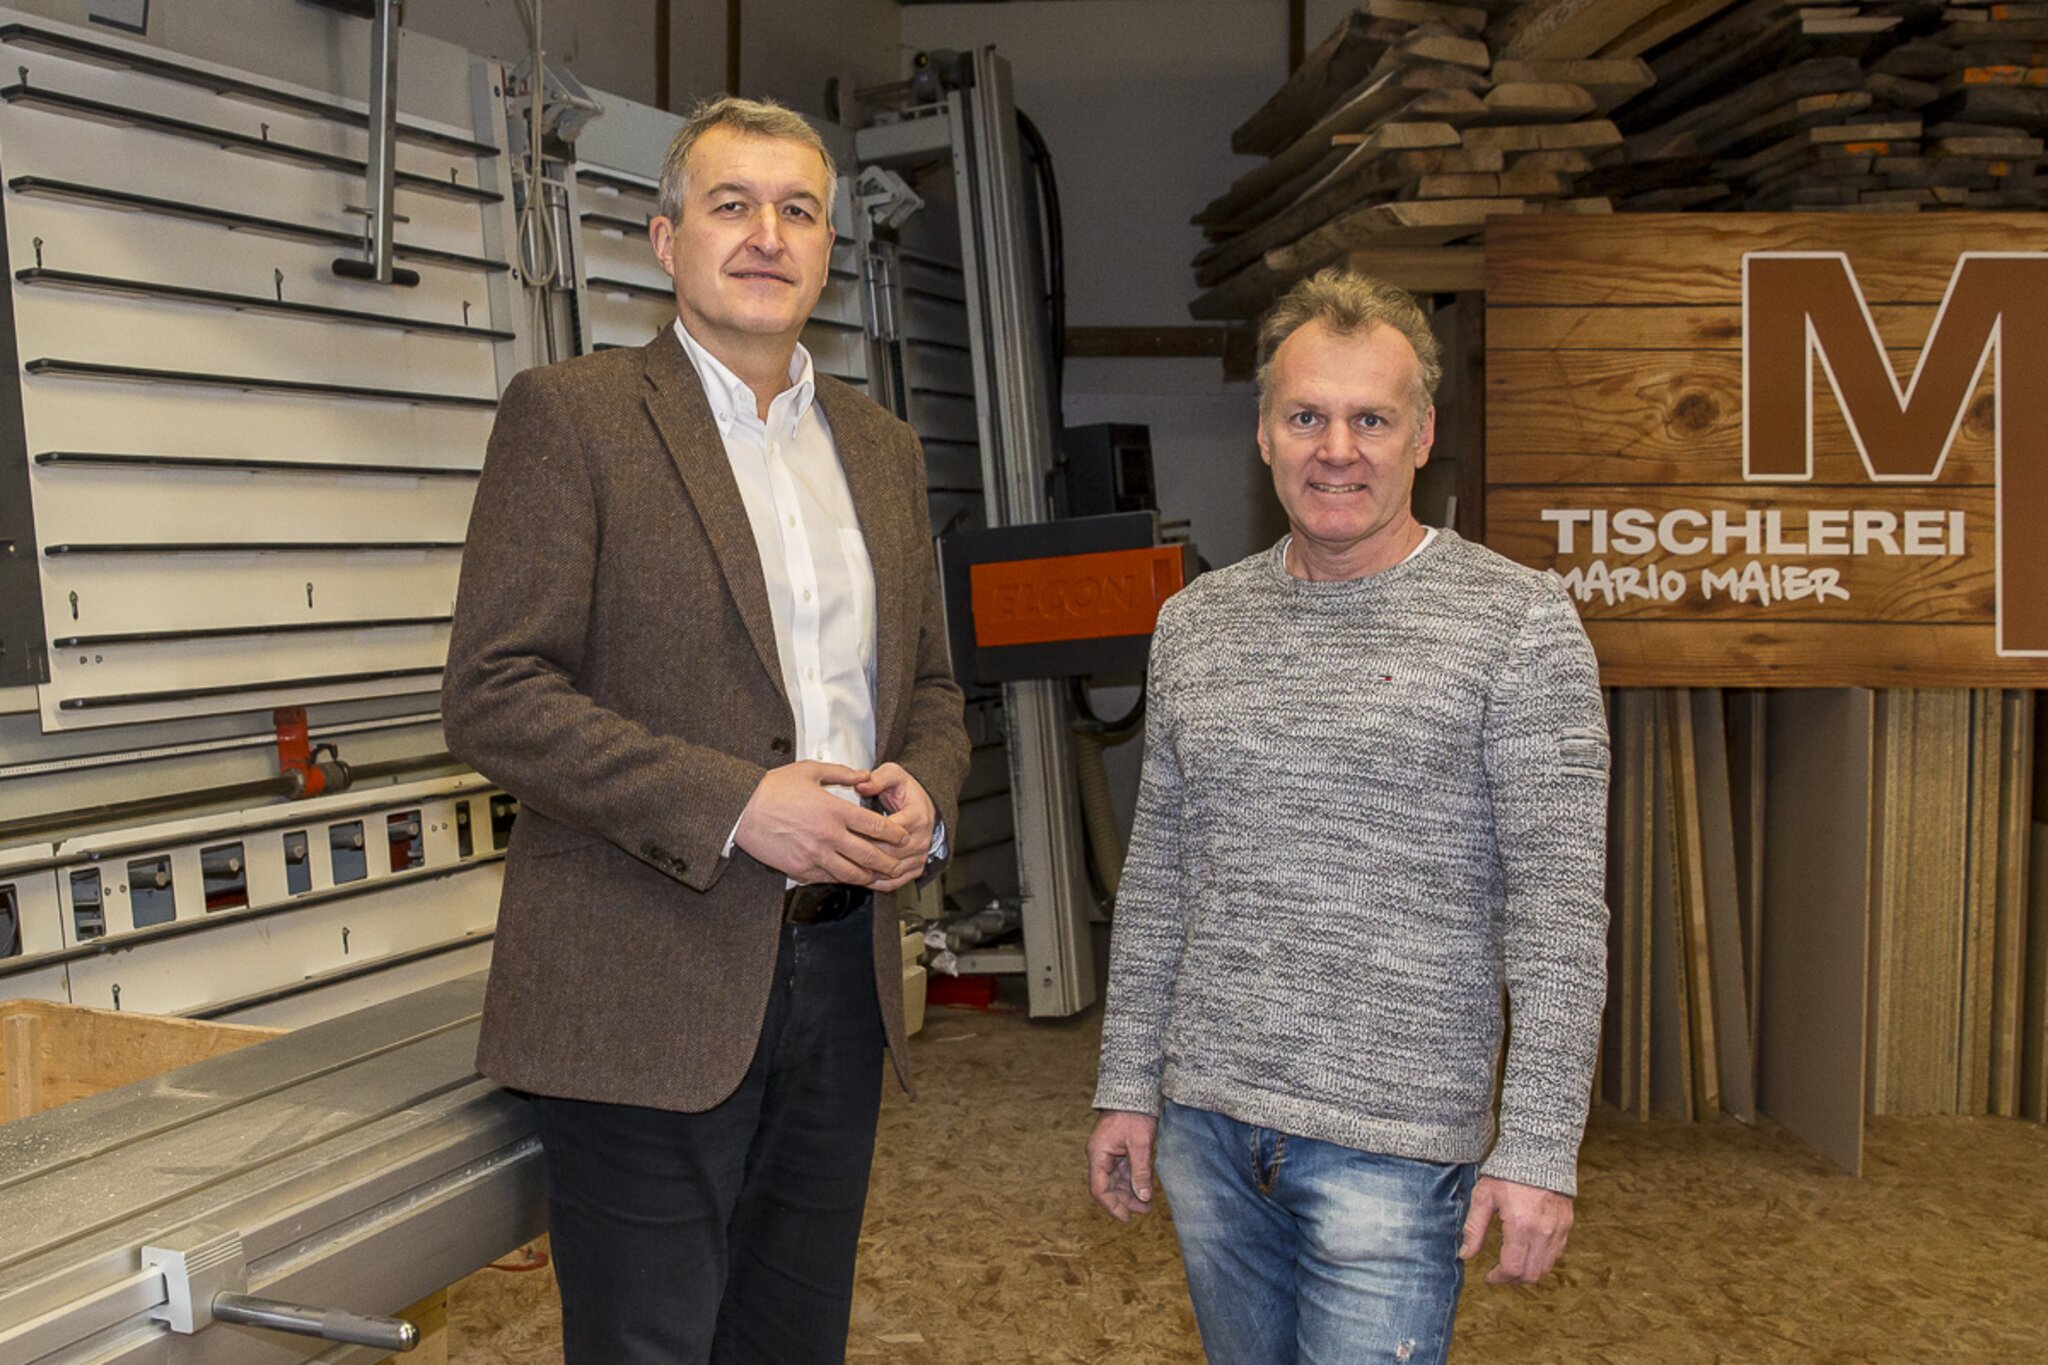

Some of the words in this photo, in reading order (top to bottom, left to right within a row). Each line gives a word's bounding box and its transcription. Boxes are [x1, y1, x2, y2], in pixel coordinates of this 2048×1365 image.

[1541, 508, 1966, 556] TISCHLEREI
[991, 574, 1136, 621] ELCON
[1547, 559, 1687, 607] MARIO
[1701, 560, 1850, 607] MAIER
